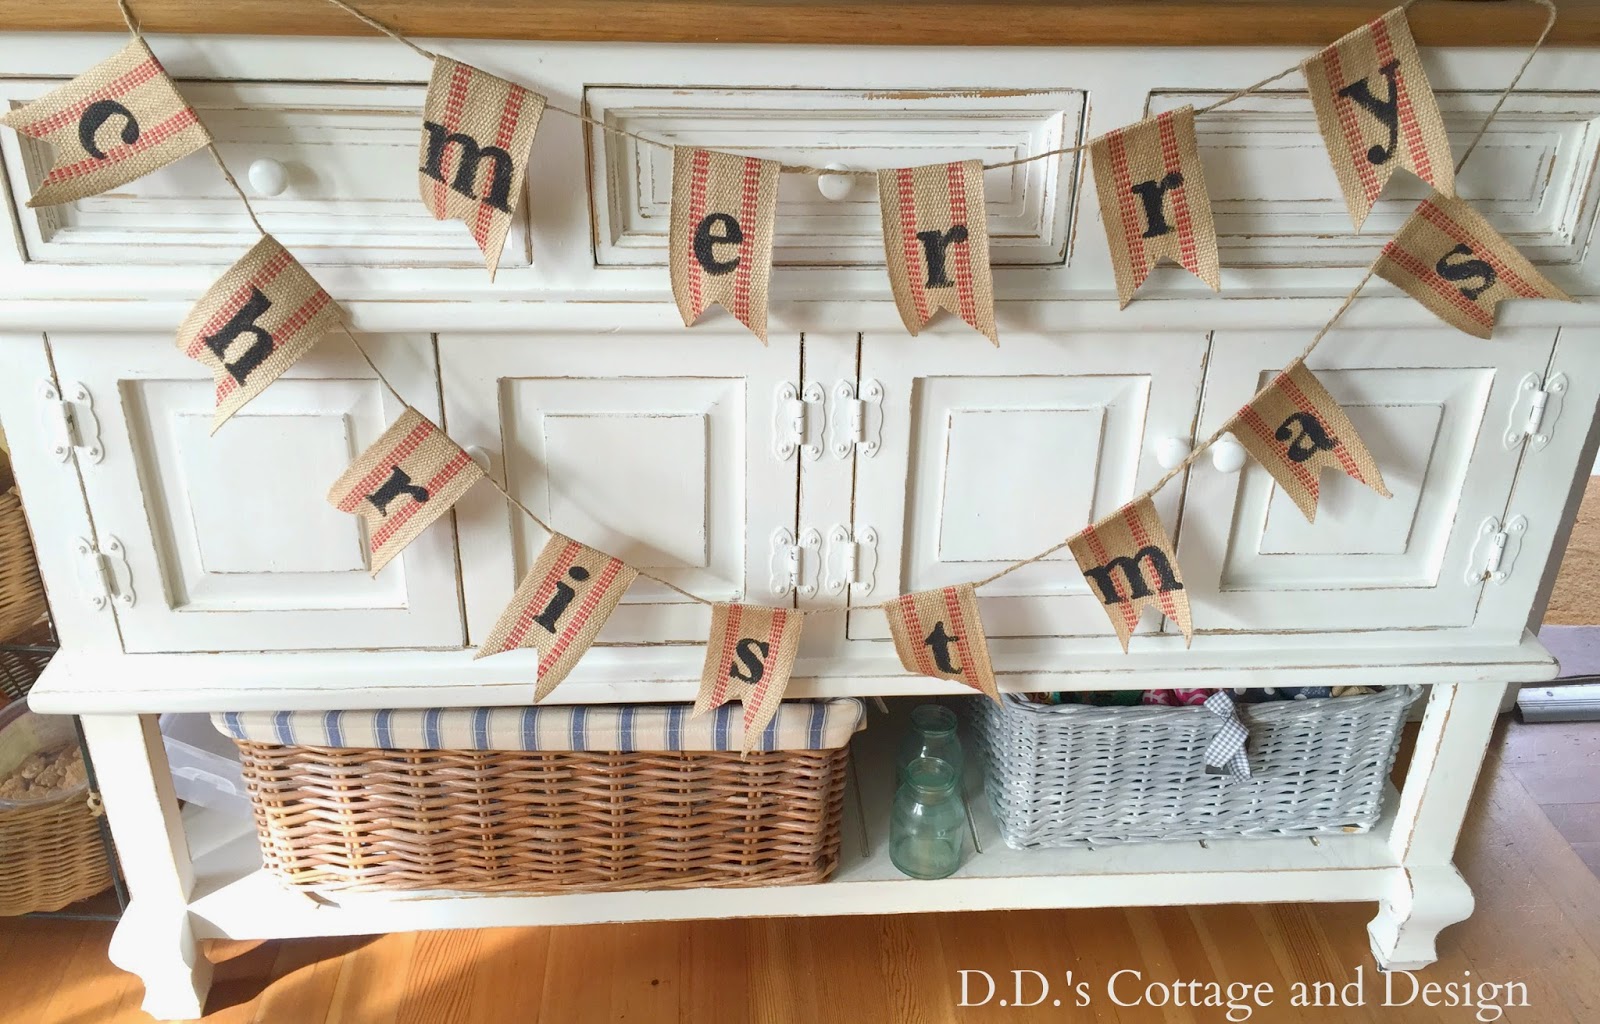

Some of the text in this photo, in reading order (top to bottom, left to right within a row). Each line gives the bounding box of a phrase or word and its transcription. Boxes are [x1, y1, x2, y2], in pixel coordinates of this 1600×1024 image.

[420, 60, 1401, 289] m e r r y
[79, 98, 1497, 684] c h r i s t m a s
